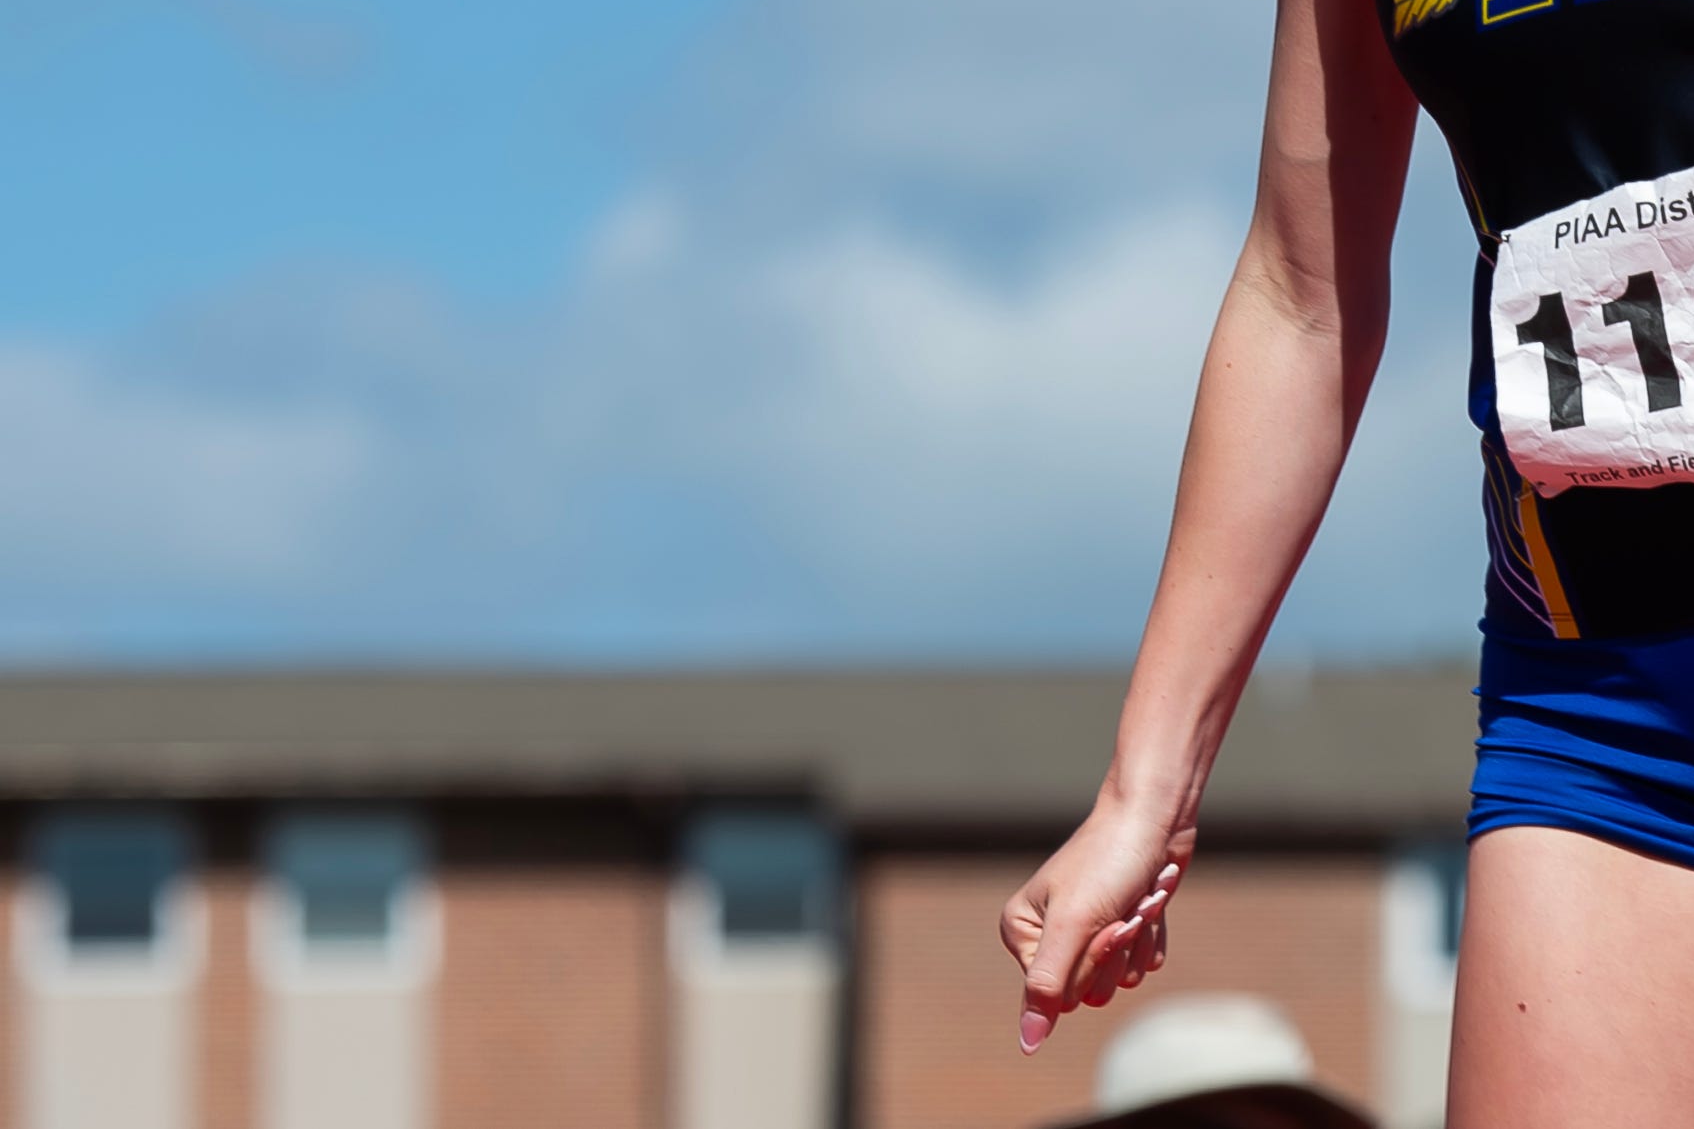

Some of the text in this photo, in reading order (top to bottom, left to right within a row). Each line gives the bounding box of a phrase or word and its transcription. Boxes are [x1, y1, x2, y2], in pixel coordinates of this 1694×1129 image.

[1554, 207, 1627, 249] PIAA
[1565, 468, 1625, 486] Track
[1628, 459, 1665, 479] and
